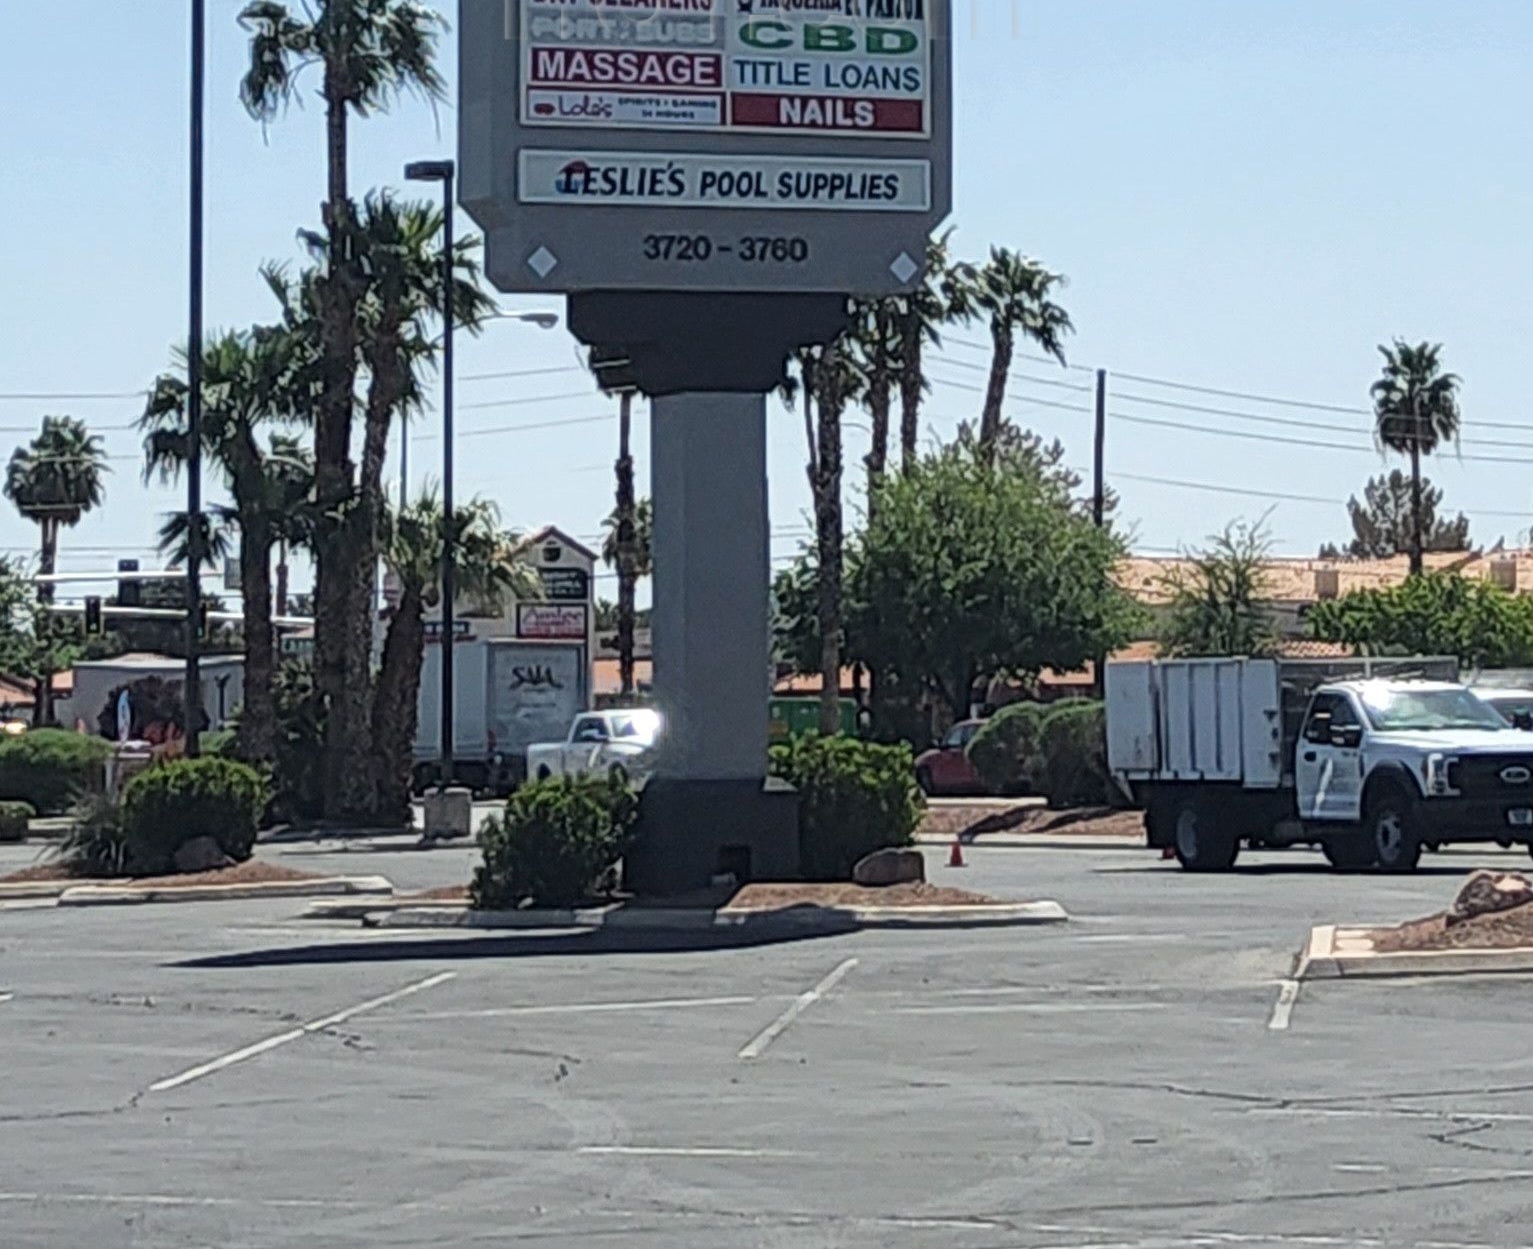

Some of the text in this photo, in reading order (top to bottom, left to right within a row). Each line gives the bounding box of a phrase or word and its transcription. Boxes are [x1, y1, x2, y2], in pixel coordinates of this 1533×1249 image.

[739, 21, 919, 54] CBD
[537, 51, 716, 84] MASSAGE
[734, 59, 920, 92] TITLE LOANS
[779, 98, 875, 127] NAILS
[562, 160, 898, 200] LESLIE'S POOL SUPPLIES
[644, 235, 711, 261] 3720
[739, 237, 808, 262] 3760
